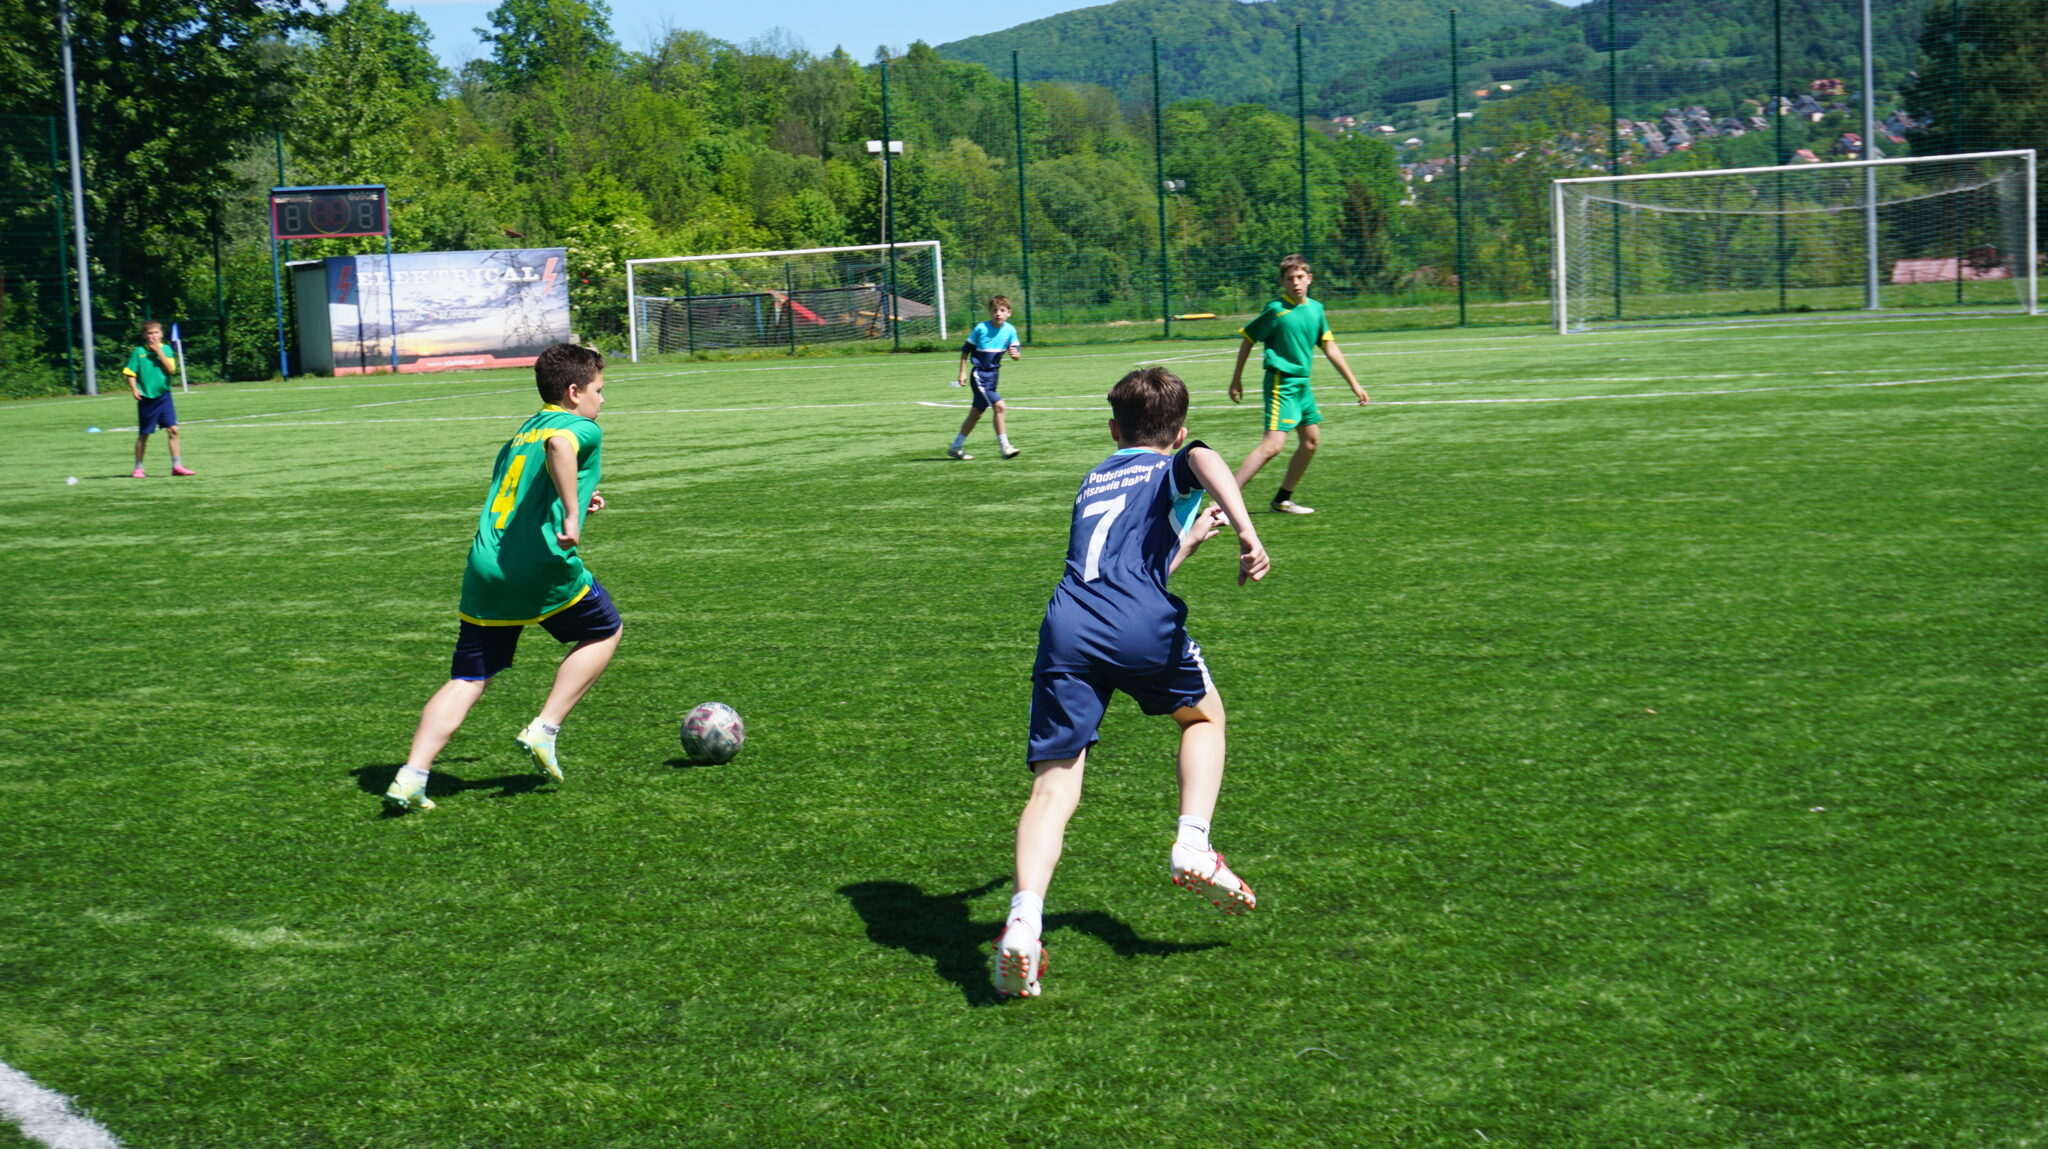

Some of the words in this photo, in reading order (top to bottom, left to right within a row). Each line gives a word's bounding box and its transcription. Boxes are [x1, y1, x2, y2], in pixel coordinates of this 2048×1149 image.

[356, 266, 540, 287] ELEKTRICAL
[490, 454, 527, 529] 4
[1083, 480, 1120, 500] Mszanie
[1082, 493, 1127, 583] 7
